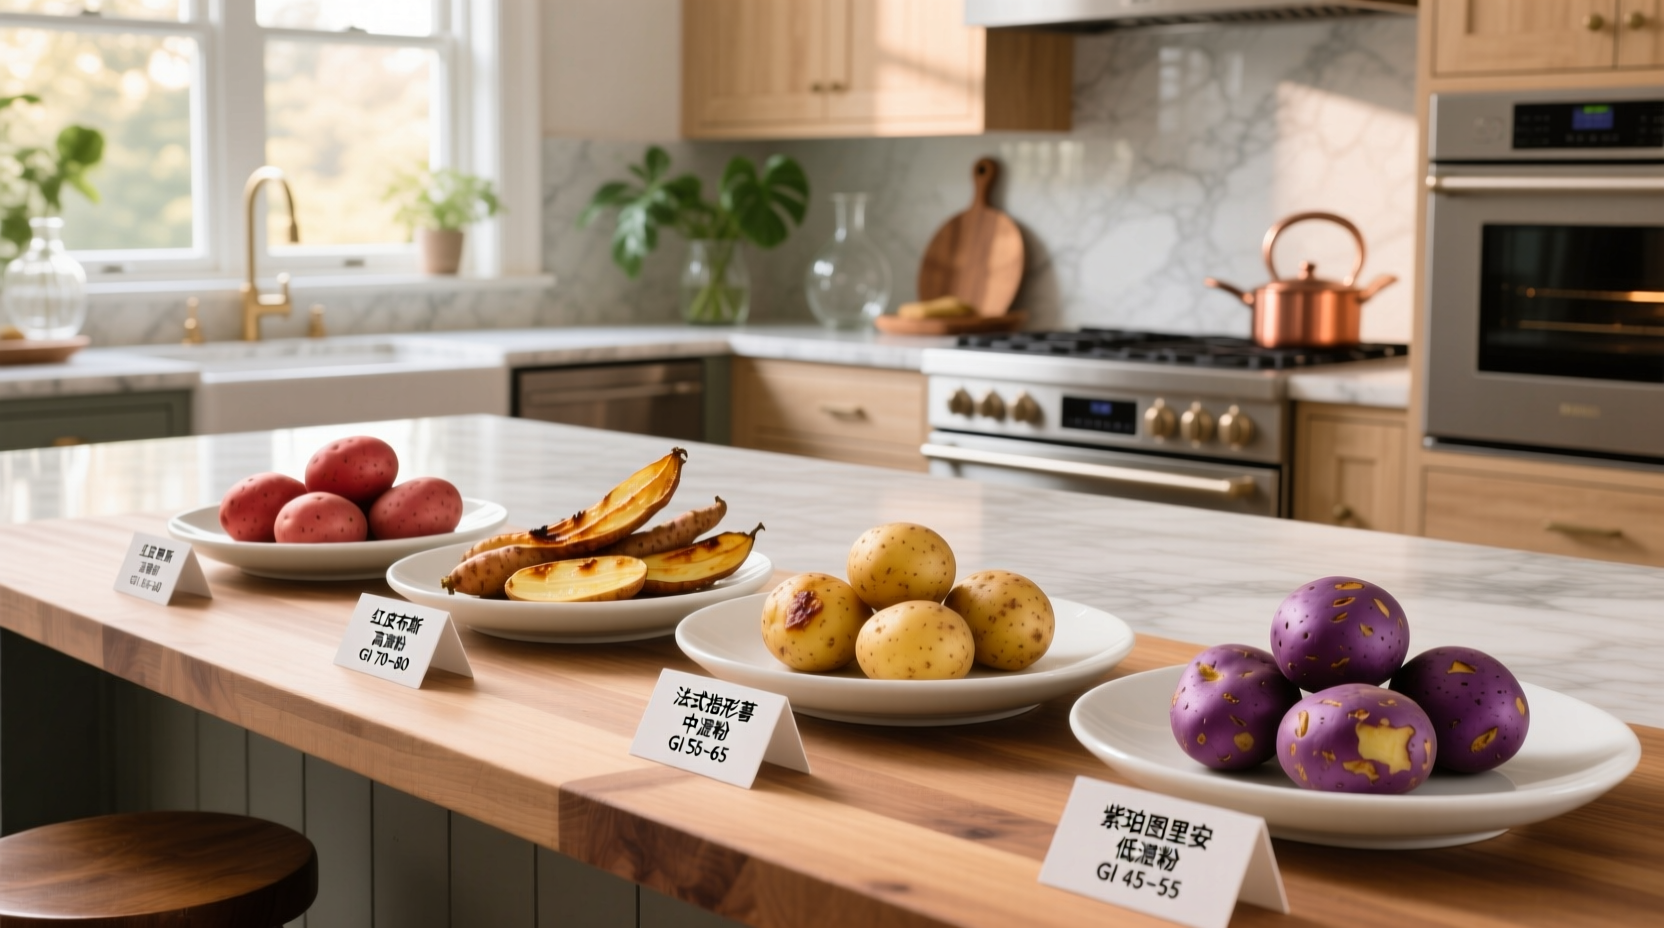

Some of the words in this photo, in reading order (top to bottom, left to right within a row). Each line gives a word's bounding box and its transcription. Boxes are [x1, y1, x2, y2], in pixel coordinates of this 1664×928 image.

[668, 735, 685, 752] GI
[1096, 862, 1118, 883] GI
[1122, 868, 1183, 899] 45-55
